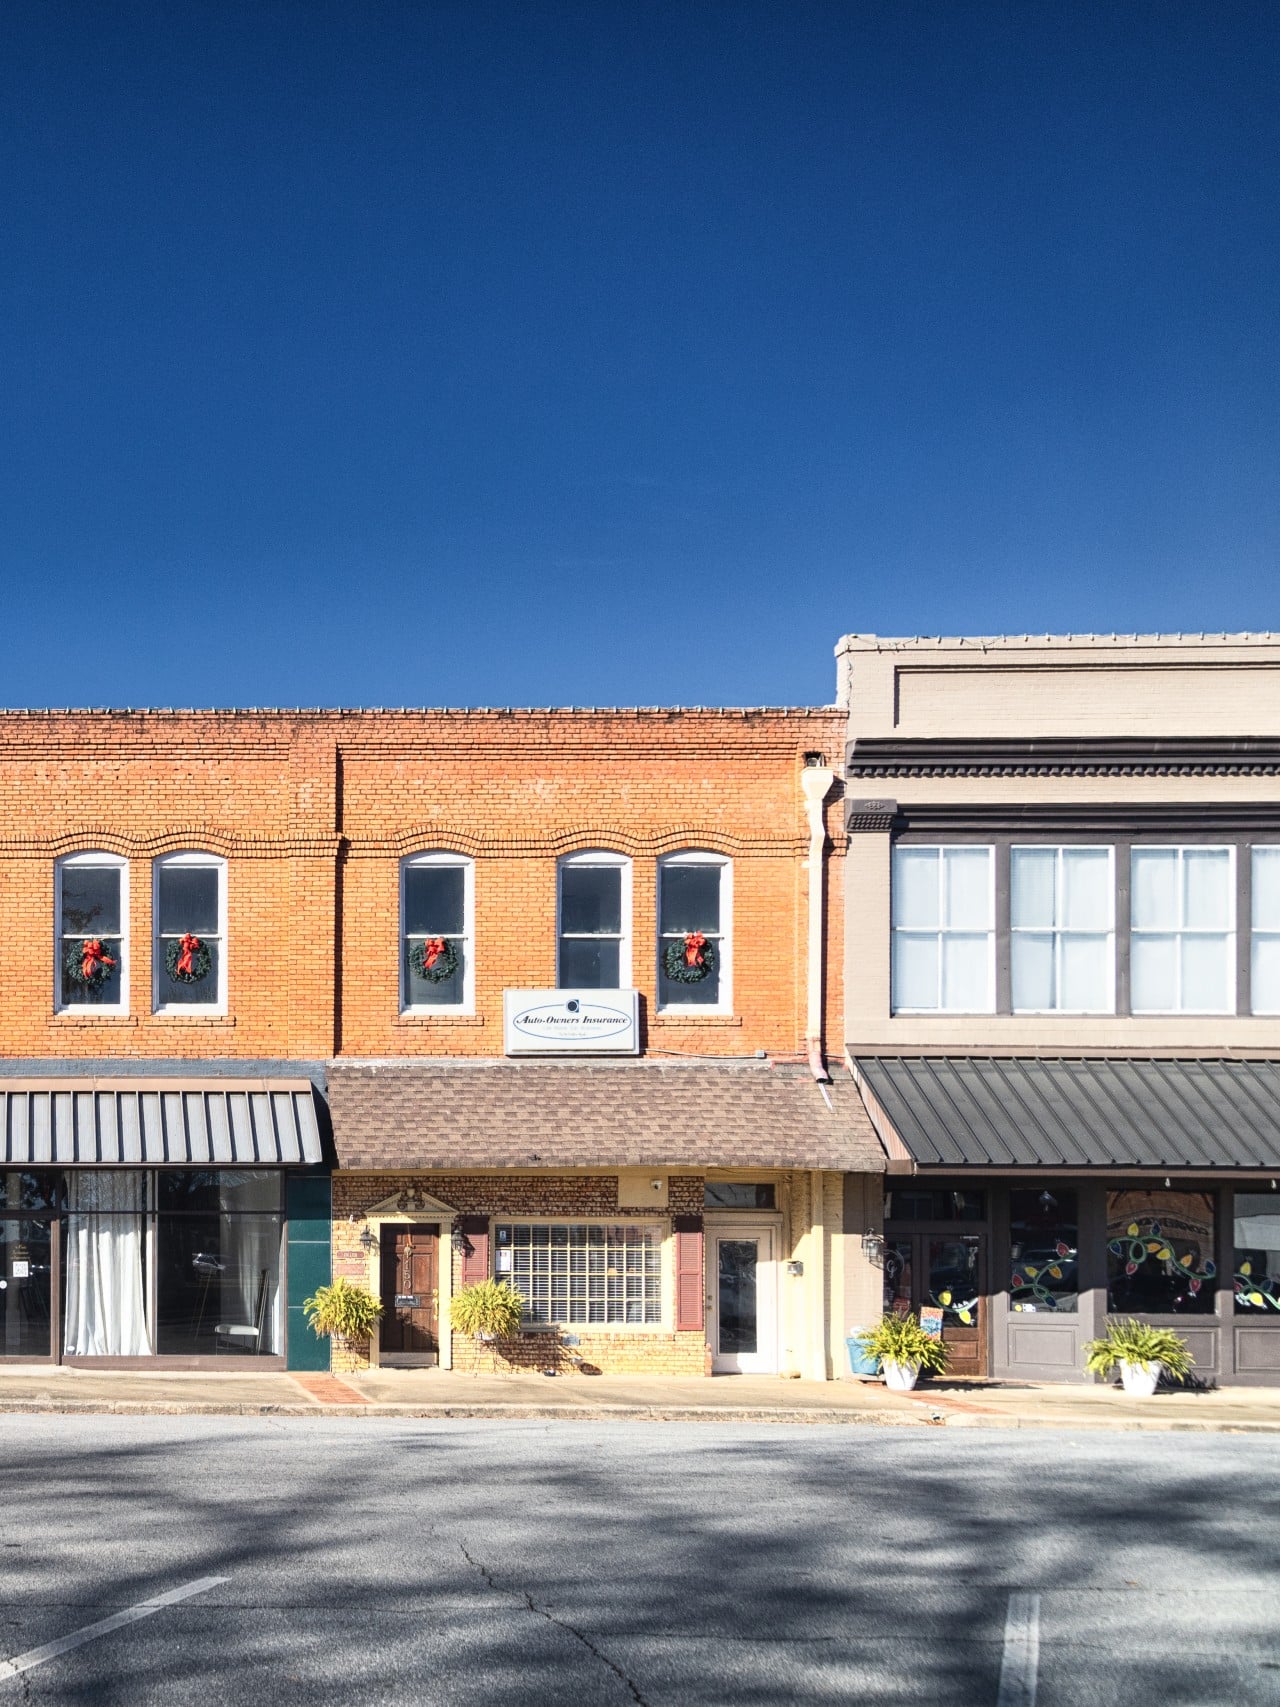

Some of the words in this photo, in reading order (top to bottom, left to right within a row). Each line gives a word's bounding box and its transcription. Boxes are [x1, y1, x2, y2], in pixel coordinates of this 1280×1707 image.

[516, 1015, 580, 1024] Auto-Owners
[582, 1015, 628, 1024] Insurance
[403, 1260, 412, 1289] 150
